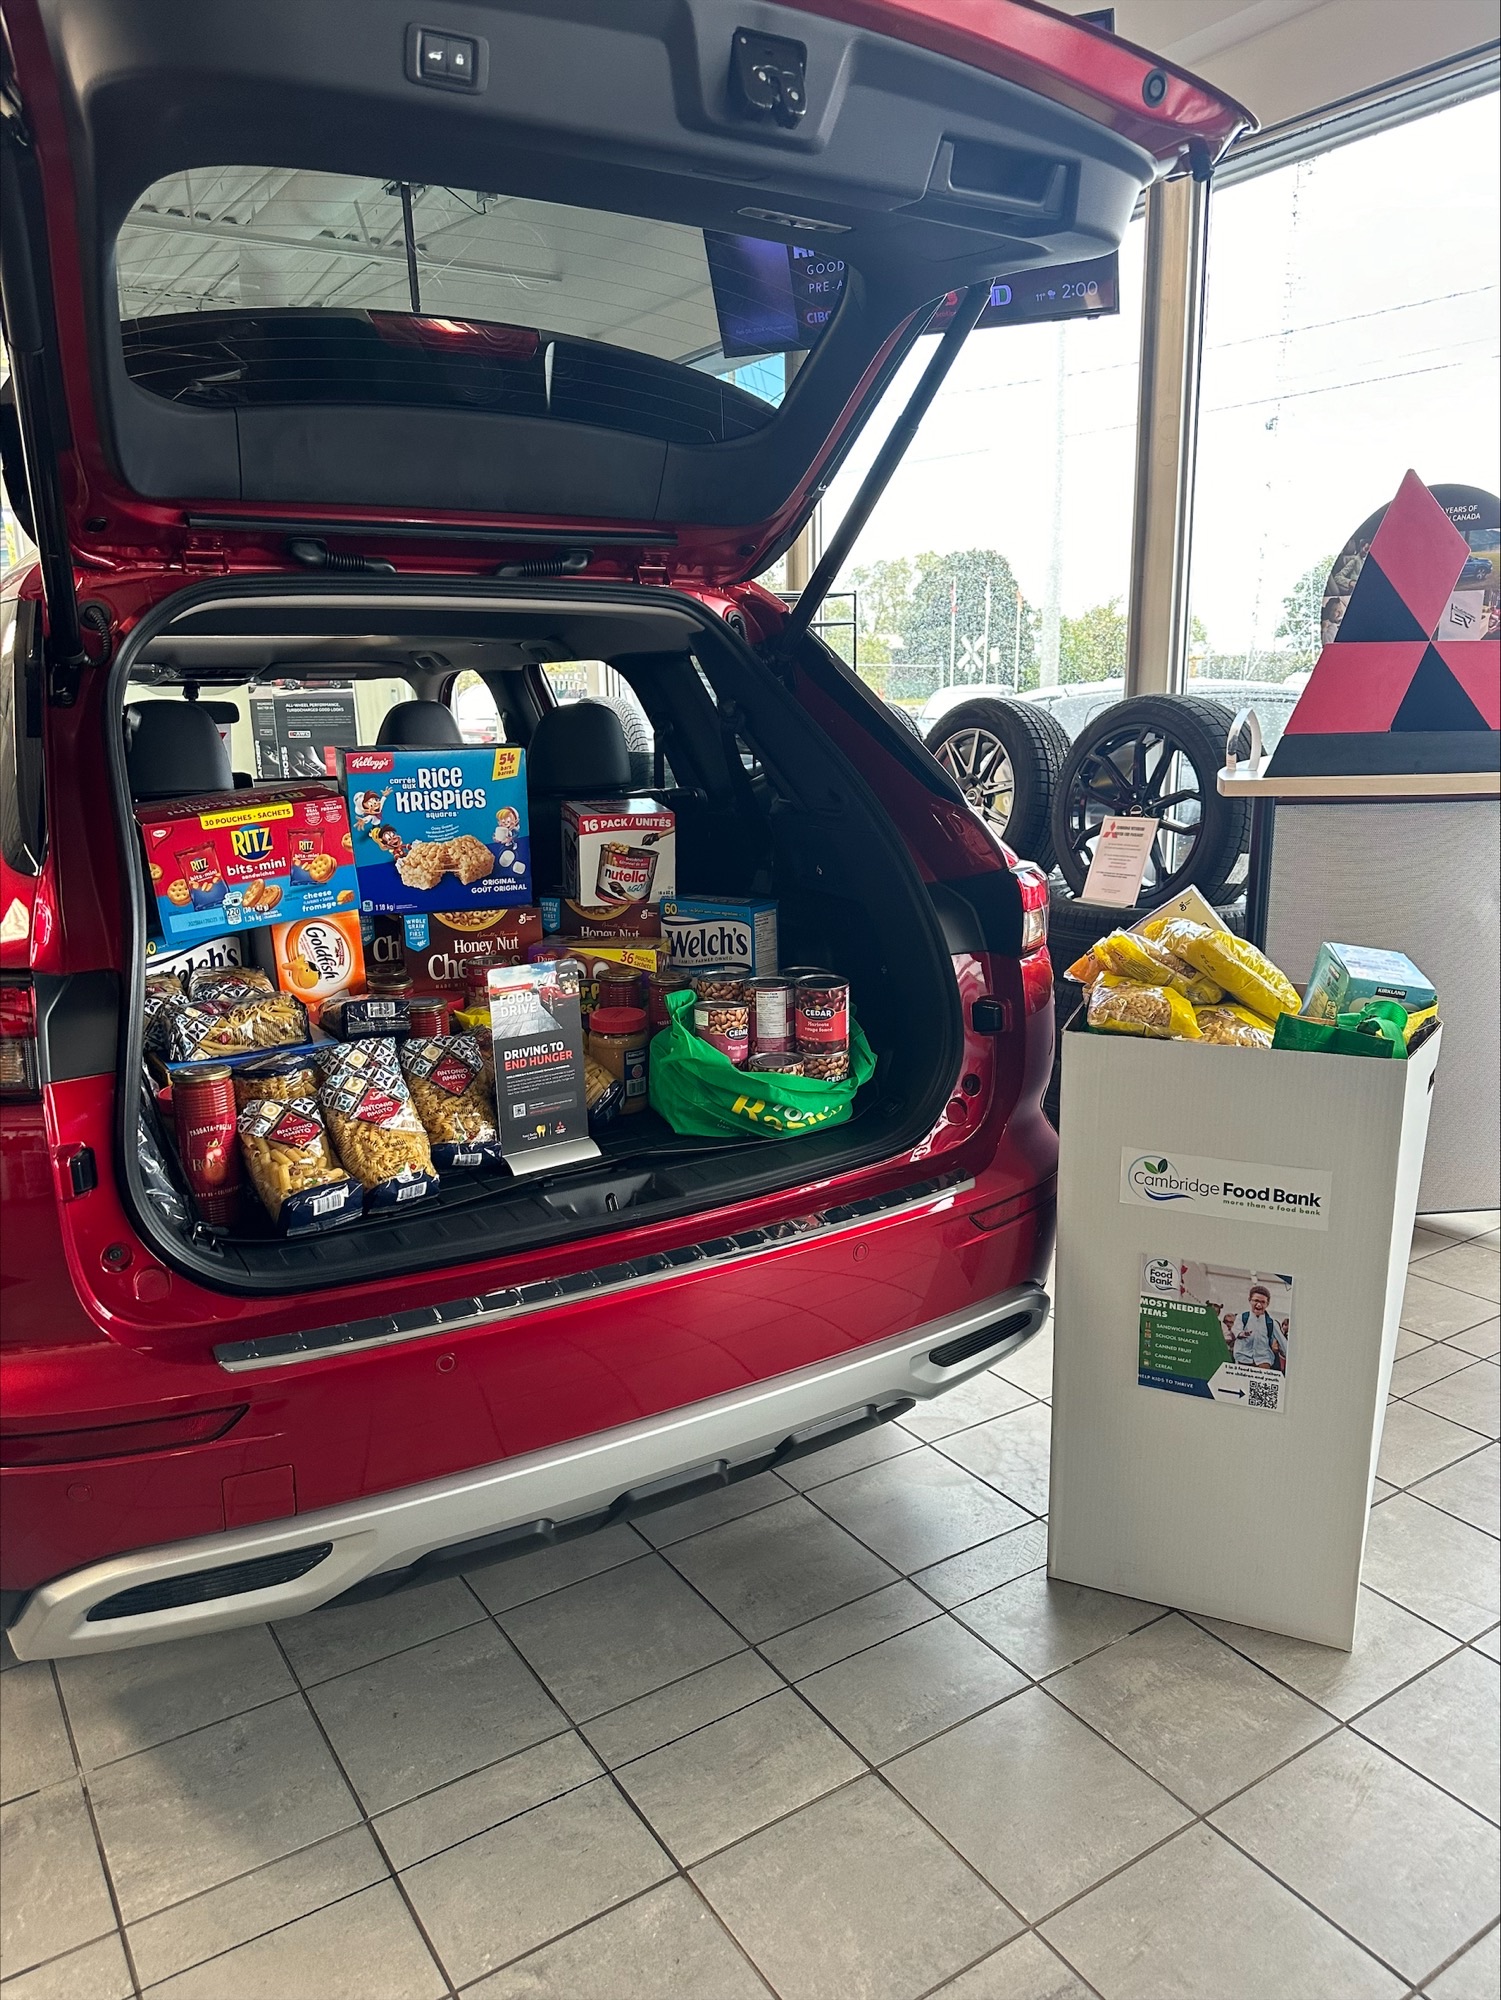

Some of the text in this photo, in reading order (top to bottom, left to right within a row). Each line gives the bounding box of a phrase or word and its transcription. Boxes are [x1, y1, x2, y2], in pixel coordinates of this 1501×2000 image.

[807, 260, 845, 275] GOOD
[1062, 280, 1098, 299] 2:00
[1445, 504, 1478, 514] YEARS OF
[1452, 513, 1481, 522] CANADA
[352, 753, 391, 770] Kellogg's
[498, 752, 515, 766] 54
[389, 776, 416, 785] carrés
[417, 766, 463, 789] Rice
[204, 808, 291, 827] 30 POUCHES SACHETS
[582, 818, 599, 832] 16
[600, 817, 628, 829] PACK
[635, 815, 672, 828] UNITÉS
[230, 826, 274, 857] RITZ
[299, 840, 314, 851] RITZ
[190, 857, 209, 872] RITZ
[226, 857, 286, 876] bits mini
[241, 870, 275, 880] sandwiches
[604, 868, 646, 883] nutella
[482, 877, 516, 886] ORIGINAL
[471, 883, 527, 894] GOÛT ORIGINAL
[303, 890, 332, 900] cheese
[226, 908, 240, 916] 220
[302, 901, 336, 912] fromage
[387, 903, 394, 912] kg
[664, 903, 678, 915] 60
[244, 915, 256, 923] 1.26
[581, 926, 640, 937] Honey Nut
[146, 941, 156, 955] 0
[454, 936, 519, 956] Honey Nut
[665, 926, 748, 958] Welch's
[305, 926, 339, 980] Goldfish
[620, 950, 634, 964] 36
[634, 960, 652, 969] sachets
[635, 955, 654, 964] pouches
[500, 991, 533, 1006] FOOD
[1377, 988, 1406, 997] KIRKLAND
[501, 1001, 538, 1018] DRIVE
[805, 1009, 832, 1017] CEDAR
[504, 1041, 564, 1061] DRIVING TO
[505, 1050, 573, 1071] END HUNGER
[437, 1068, 469, 1077] ANTONIO
[441, 1073, 467, 1082] AMATO
[360, 1101, 394, 1113] ANTONIO
[366, 1106, 394, 1118] AMATO
[276, 1122, 313, 1136] ANTONIO
[282, 1128, 311, 1138] AMATO
[1133, 1171, 1322, 1208] Cambridge Food Bank
[1222, 1199, 1244, 1207] more
[1247, 1201, 1266, 1209] than
[1276, 1205, 1297, 1213] food
[1299, 1207, 1321, 1216] bank
[1150, 1269, 1173, 1279] Food
[1150, 1276, 1173, 1286] Bank
[1140, 1297, 1207, 1315] MOST NEEDED
[1140, 1306, 1168, 1318] ITEMS
[1156, 1323, 1209, 1337] SANDWICH SPREADS
[1155, 1333, 1199, 1345] SCHOOL SNACKS
[1155, 1343, 1177, 1351] CANNED
[1154, 1353, 1177, 1361] CANNED
[1174, 1380, 1194, 1389] THRIVE
